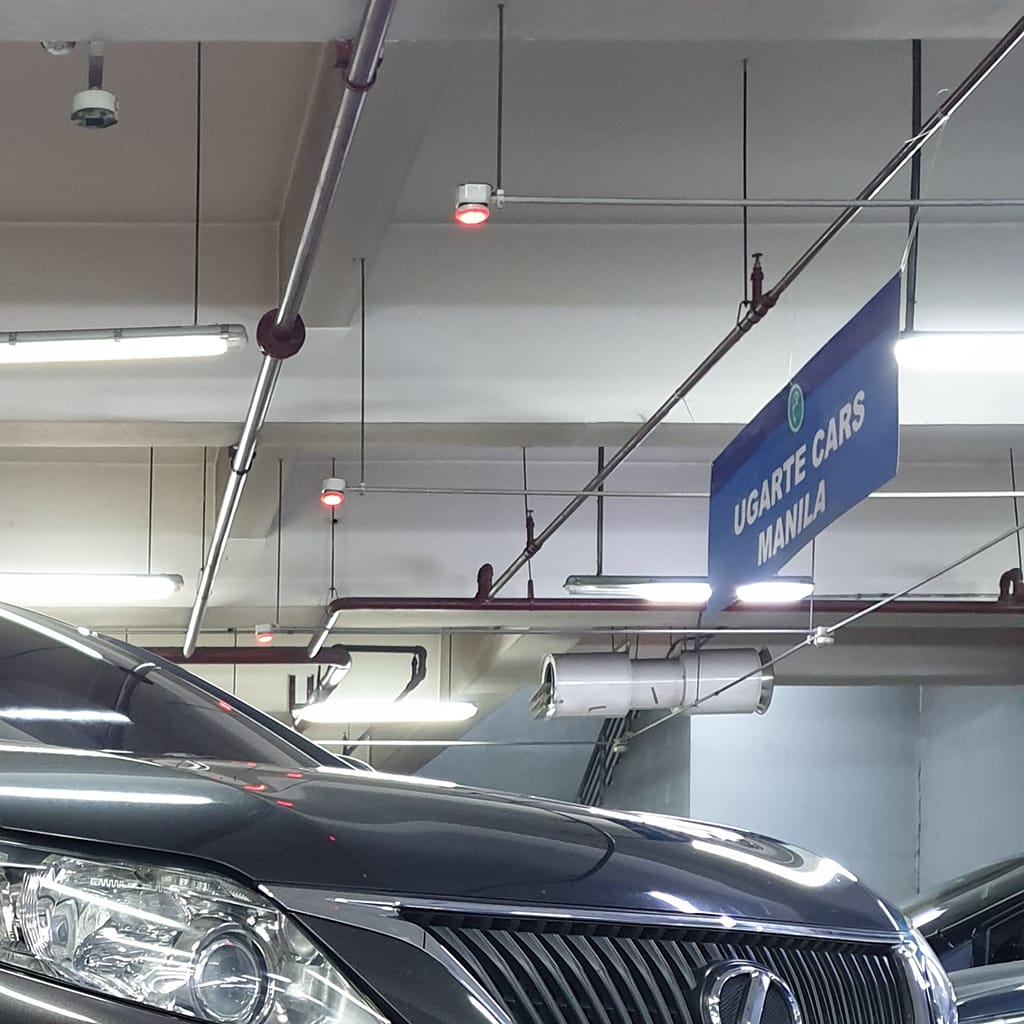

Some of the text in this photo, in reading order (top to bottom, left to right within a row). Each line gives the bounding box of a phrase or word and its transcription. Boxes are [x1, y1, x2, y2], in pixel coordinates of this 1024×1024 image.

[734, 390, 865, 536] UGARTE CARS
[757, 479, 826, 567] MANILA
